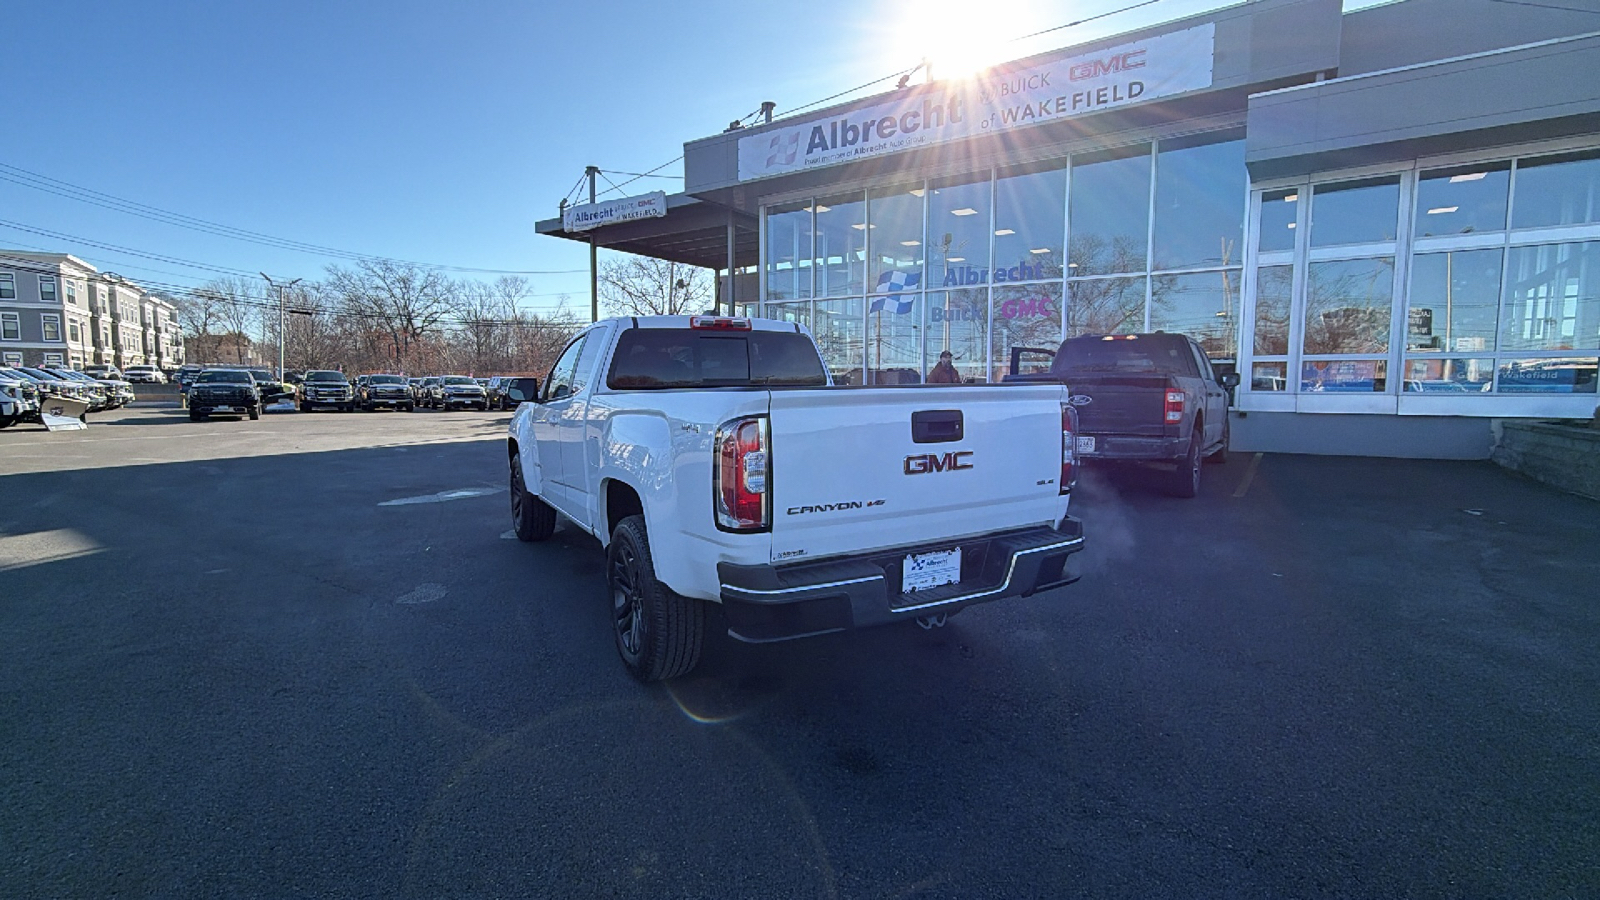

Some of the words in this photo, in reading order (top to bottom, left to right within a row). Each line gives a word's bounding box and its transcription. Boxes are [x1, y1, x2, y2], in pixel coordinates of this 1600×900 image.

[1001, 71, 1050, 97] BUICK
[1069, 49, 1147, 82] GMC
[981, 112, 996, 129] of
[1000, 80, 1145, 124] WAKEFIELD
[805, 94, 963, 155] Albrecht
[853, 142, 887, 156] Albrecht
[574, 206, 614, 223] Albrecht
[621, 208, 658, 220] WAKEFIELD
[942, 260, 1044, 288] Albrecht
[931, 305, 984, 323] Buick
[1001, 297, 1053, 319] GMC
[1502, 371, 1559, 379] Wakefield
[903, 451, 974, 476] GMC
[786, 501, 863, 516] CANYON
